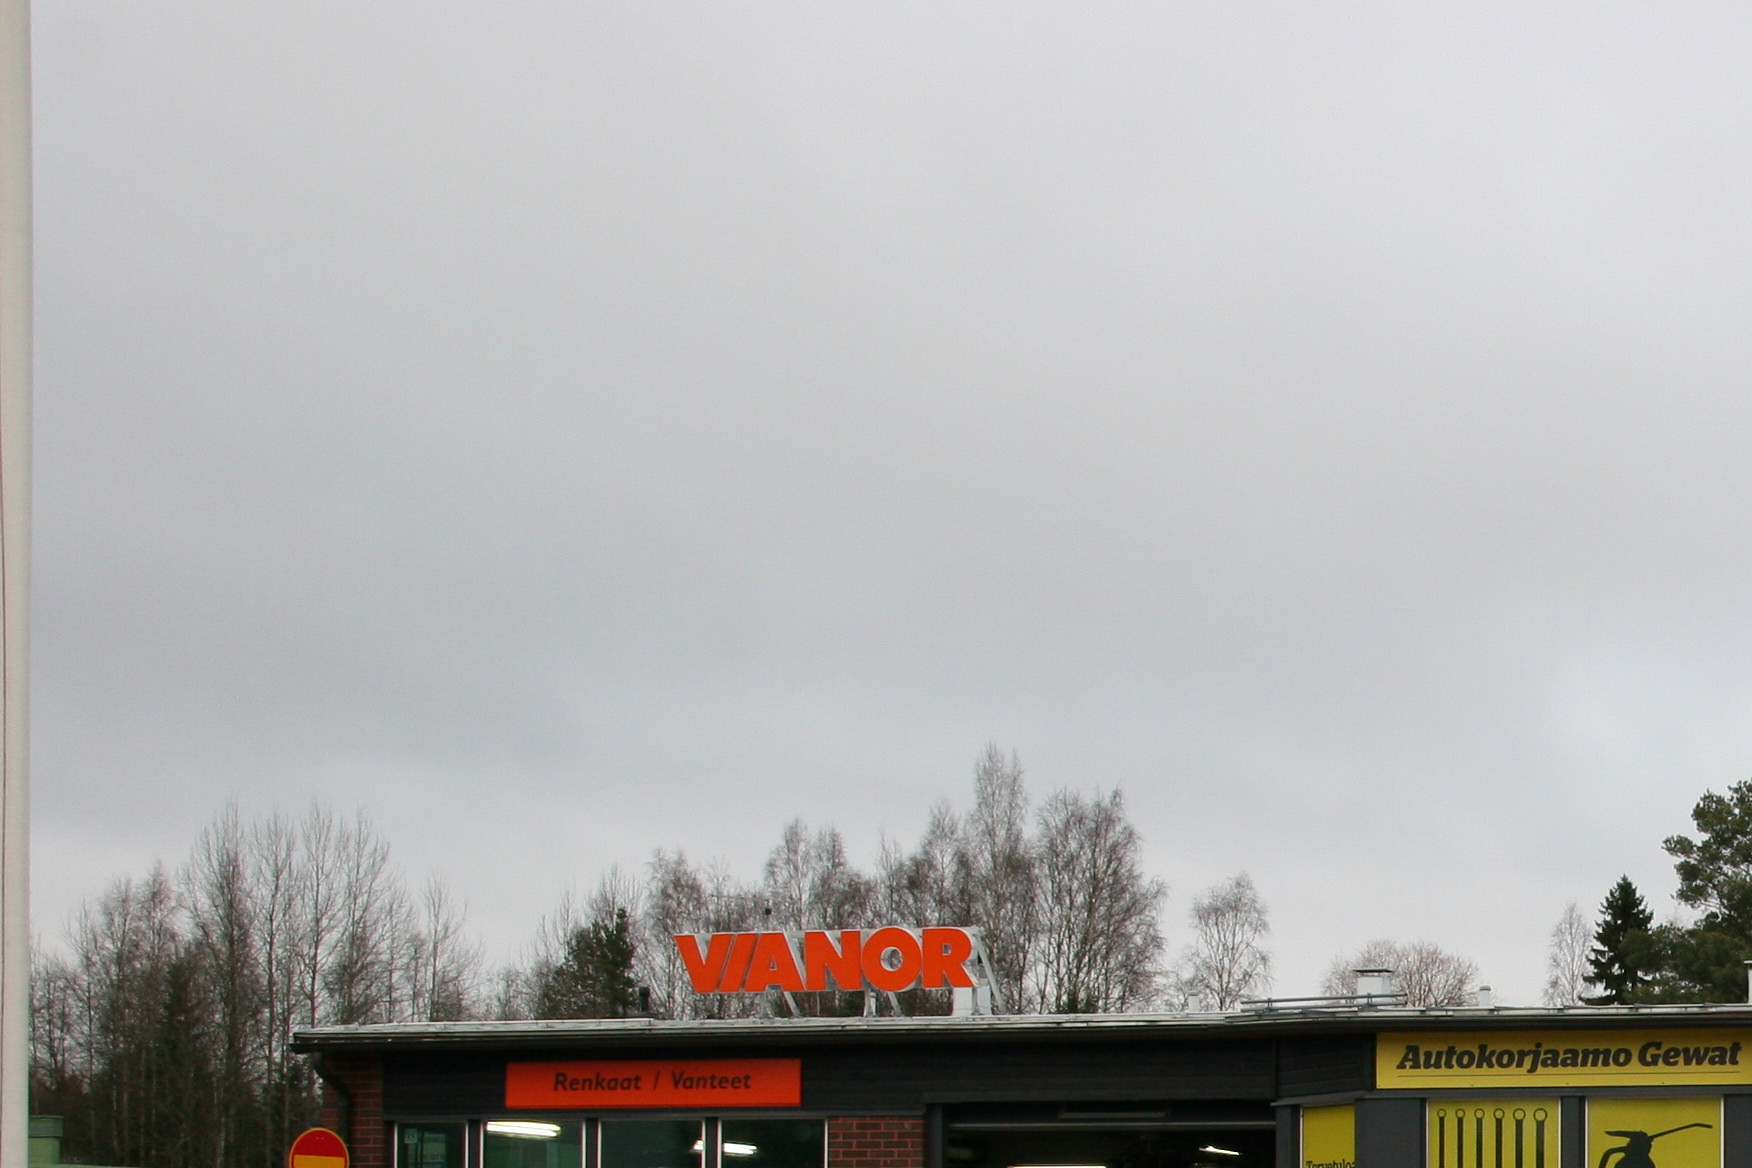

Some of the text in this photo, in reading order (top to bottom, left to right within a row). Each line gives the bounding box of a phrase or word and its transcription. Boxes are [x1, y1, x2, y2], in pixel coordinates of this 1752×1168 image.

[673, 926, 978, 993] VIANOR
[1396, 1041, 1743, 1074] Autokorjaamo Gewat
[553, 1072, 642, 1091] Renkaat
[671, 1070, 753, 1090] Vanteet
